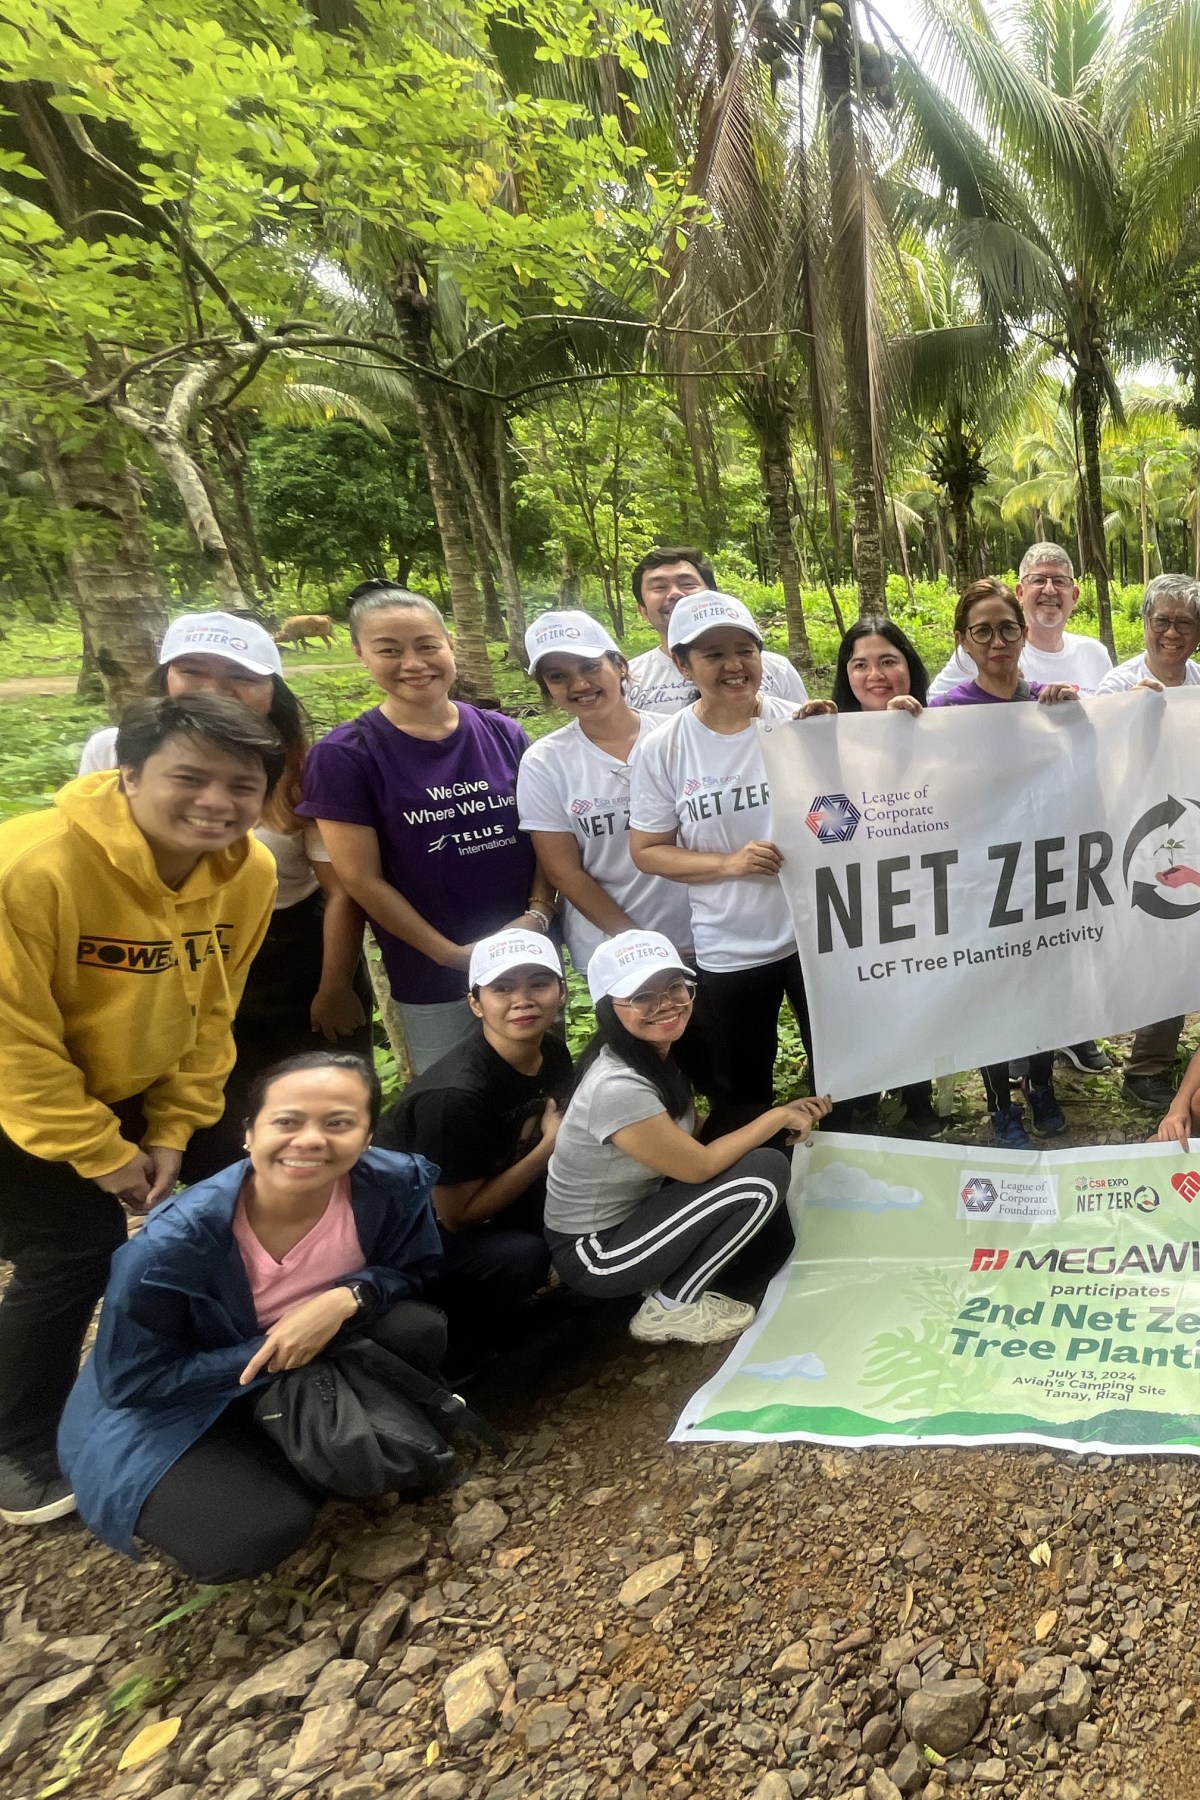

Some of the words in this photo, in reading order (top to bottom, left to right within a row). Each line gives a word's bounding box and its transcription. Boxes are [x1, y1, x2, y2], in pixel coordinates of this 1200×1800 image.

[693, 609, 708, 621] NET
[184, 633, 205, 643] NET
[536, 631, 548, 646] NET
[426, 786, 453, 801] We
[453, 780, 489, 797] Give
[862, 791, 910, 806] League
[914, 784, 929, 799] of
[403, 808, 455, 825] Where
[456, 800, 486, 816] We
[487, 795, 515, 809] Live
[686, 790, 723, 823] NET
[864, 805, 933, 823] Corporate
[452, 825, 503, 843] TELUS
[866, 820, 949, 840] Foundations
[458, 835, 517, 856] International
[814, 849, 958, 954] NET
[489, 947, 506, 960] NET
[618, 952, 635, 966] NET
[857, 960, 897, 982] LCF
[901, 955, 948, 975] Tree
[953, 939, 1032, 967] Planting
[1036, 926, 1104, 951] Activity
[1001, 1180, 1033, 1193] League
[1035, 1181, 1048, 1191] of
[1089, 1180, 1106, 1188] CSR
[1108, 1178, 1129, 1187] EXPO
[999, 1192, 1048, 1205] Corporate
[1077, 1194, 1103, 1213] NET
[998, 1204, 1056, 1216] Foundations
[1050, 1283, 1170, 1300] participates
[957, 1297, 1045, 1326] 2nd
[1051, 1303, 1137, 1332] Net
[950, 1328, 1056, 1360] Tree
[1047, 1369, 1077, 1380] July
[1081, 1371, 1097, 1381] 13,
[1101, 1371, 1136, 1381] 2024
[1012, 1376, 1065, 1388] Aviah's
[1069, 1379, 1134, 1393] Camping
[1138, 1385, 1167, 1396] Site
[1044, 1388, 1091, 1402] Tanay,
[1096, 1391, 1130, 1402] Rizal
